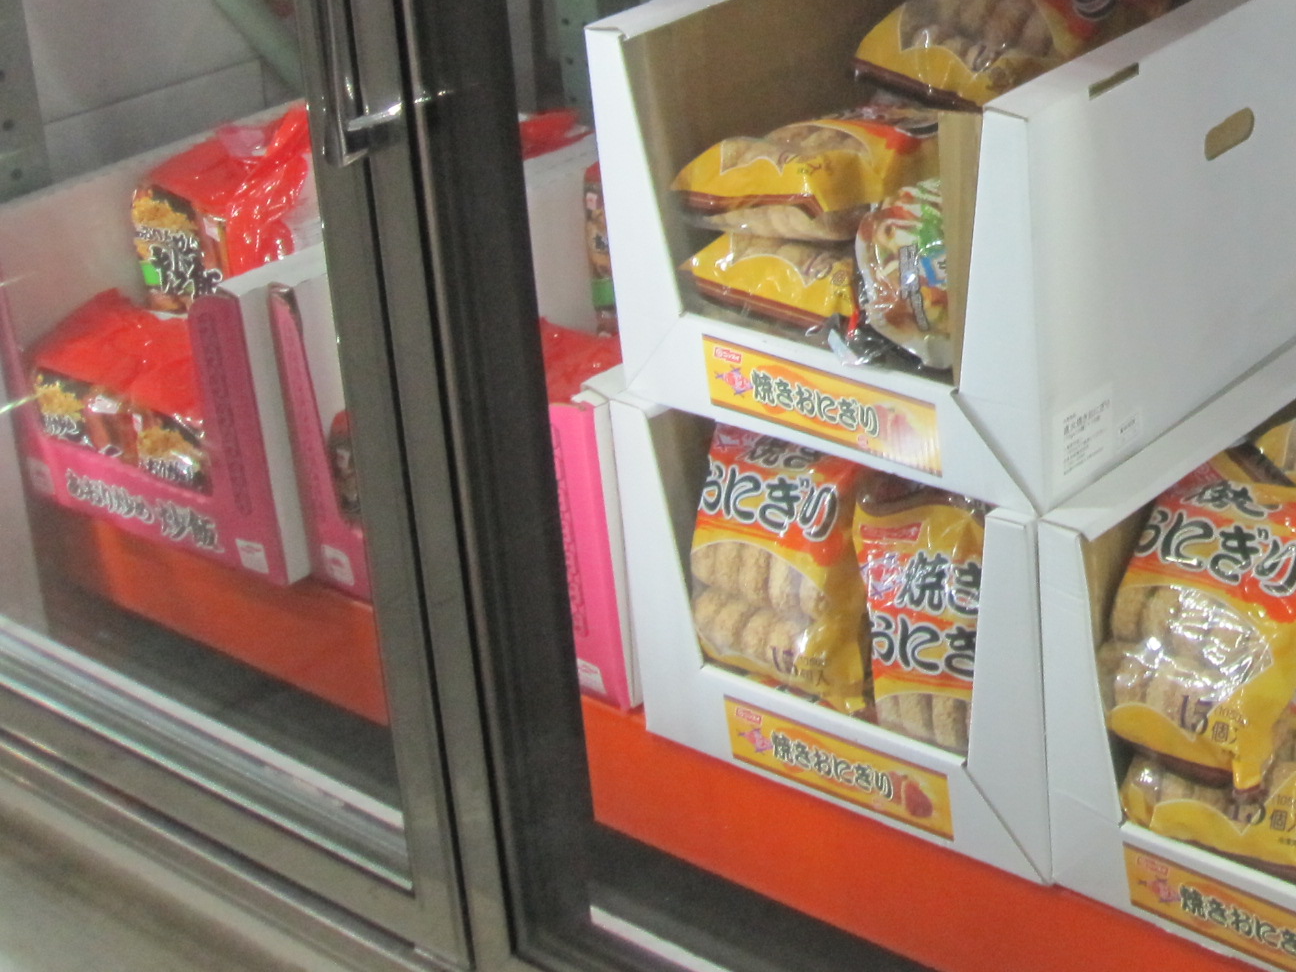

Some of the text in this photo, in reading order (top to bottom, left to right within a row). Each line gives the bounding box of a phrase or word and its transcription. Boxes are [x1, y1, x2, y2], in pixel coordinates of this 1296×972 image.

[751, 370, 879, 436] 焼きおにぎり
[897, 550, 982, 616] 焼き
[770, 728, 895, 801] 焼きおにぎり
